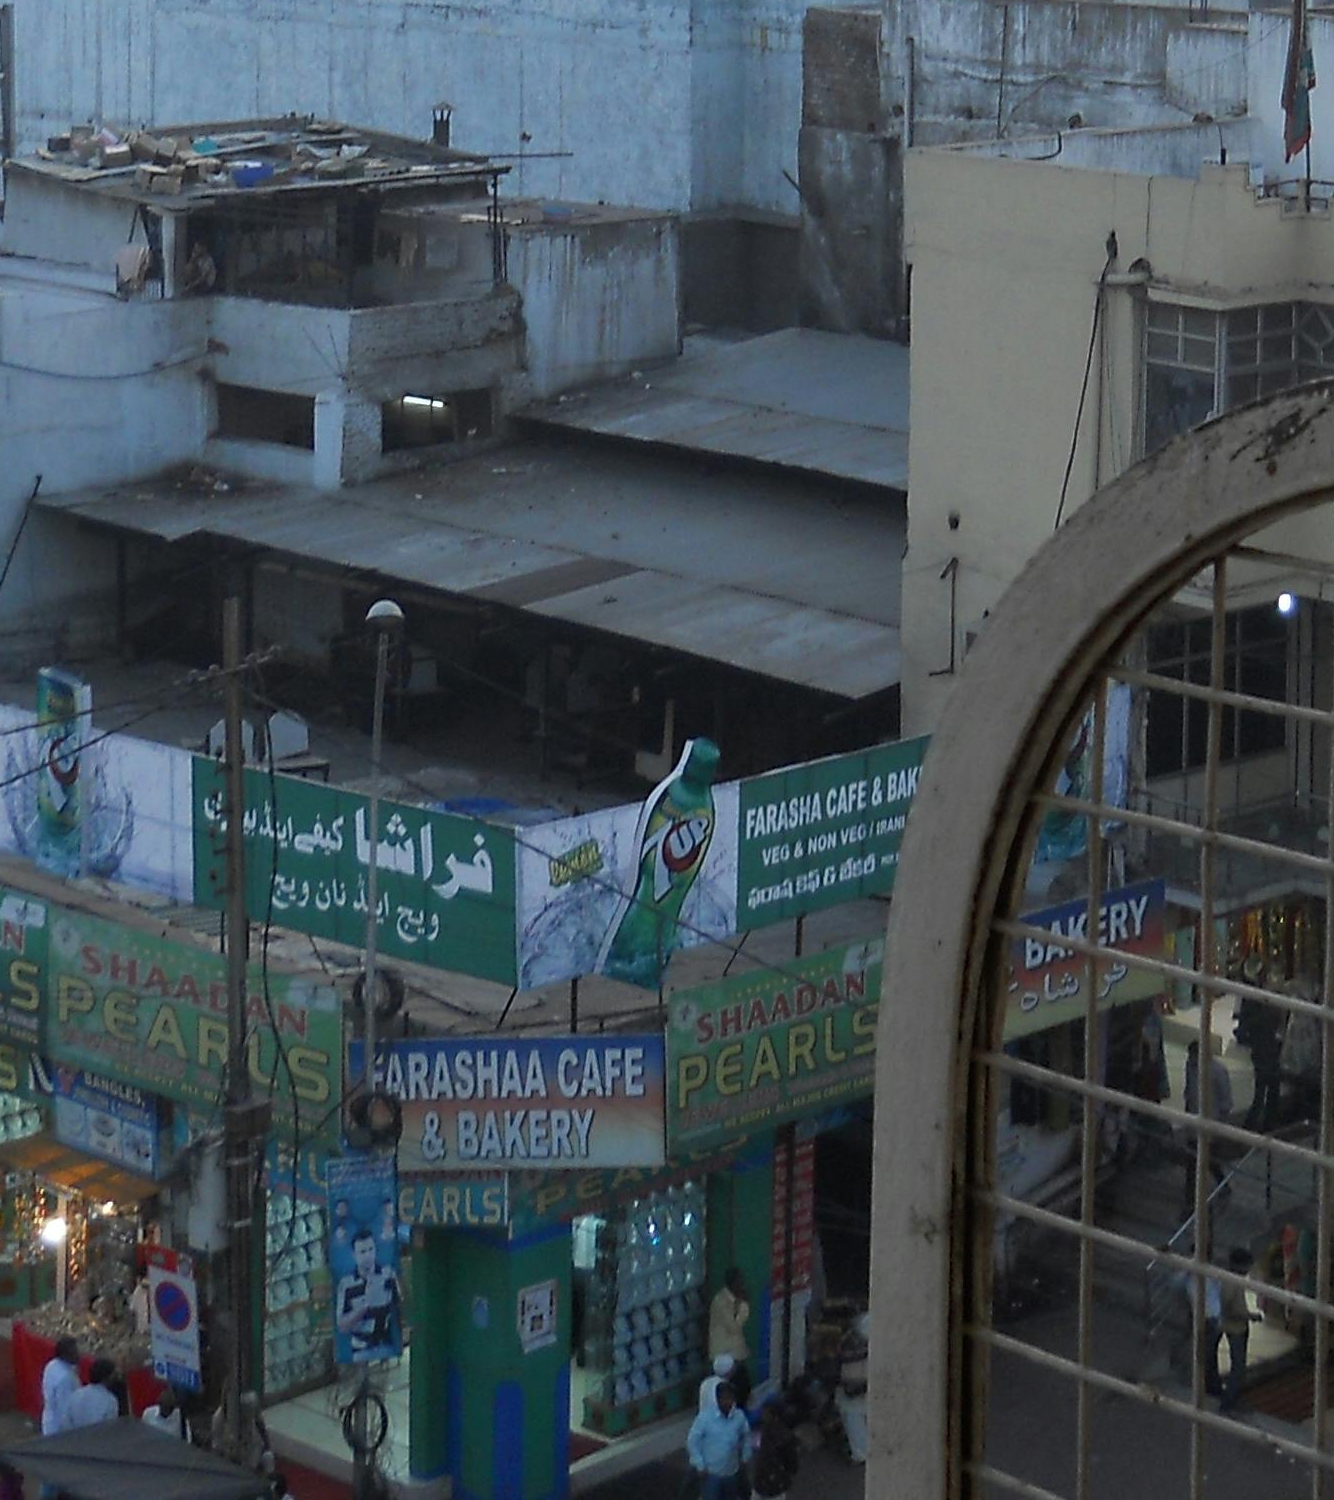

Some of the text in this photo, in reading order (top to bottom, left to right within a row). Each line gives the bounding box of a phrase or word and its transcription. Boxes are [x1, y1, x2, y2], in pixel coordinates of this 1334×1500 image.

[745, 797, 822, 840] FARASHA
[825, 779, 870, 820] CAFE
[871, 776, 884, 803] &
[762, 843, 791, 867] VEG
[793, 840, 805, 858] &
[807, 832, 838, 856] NON
[840, 823, 868, 846] VEG
[1025, 894, 1149, 971] BAKERY
[80, 944, 310, 1039] SHAADAN
[697, 971, 866, 1045] SHAADAN
[58, 974, 331, 1102] PEARLS
[677, 1005, 879, 1110] PEARLS
[372, 1047, 645, 1099] FARASHAA CAFE
[422, 1108, 594, 1160] & BAKERY
[399, 1184, 504, 1226] EARLS
